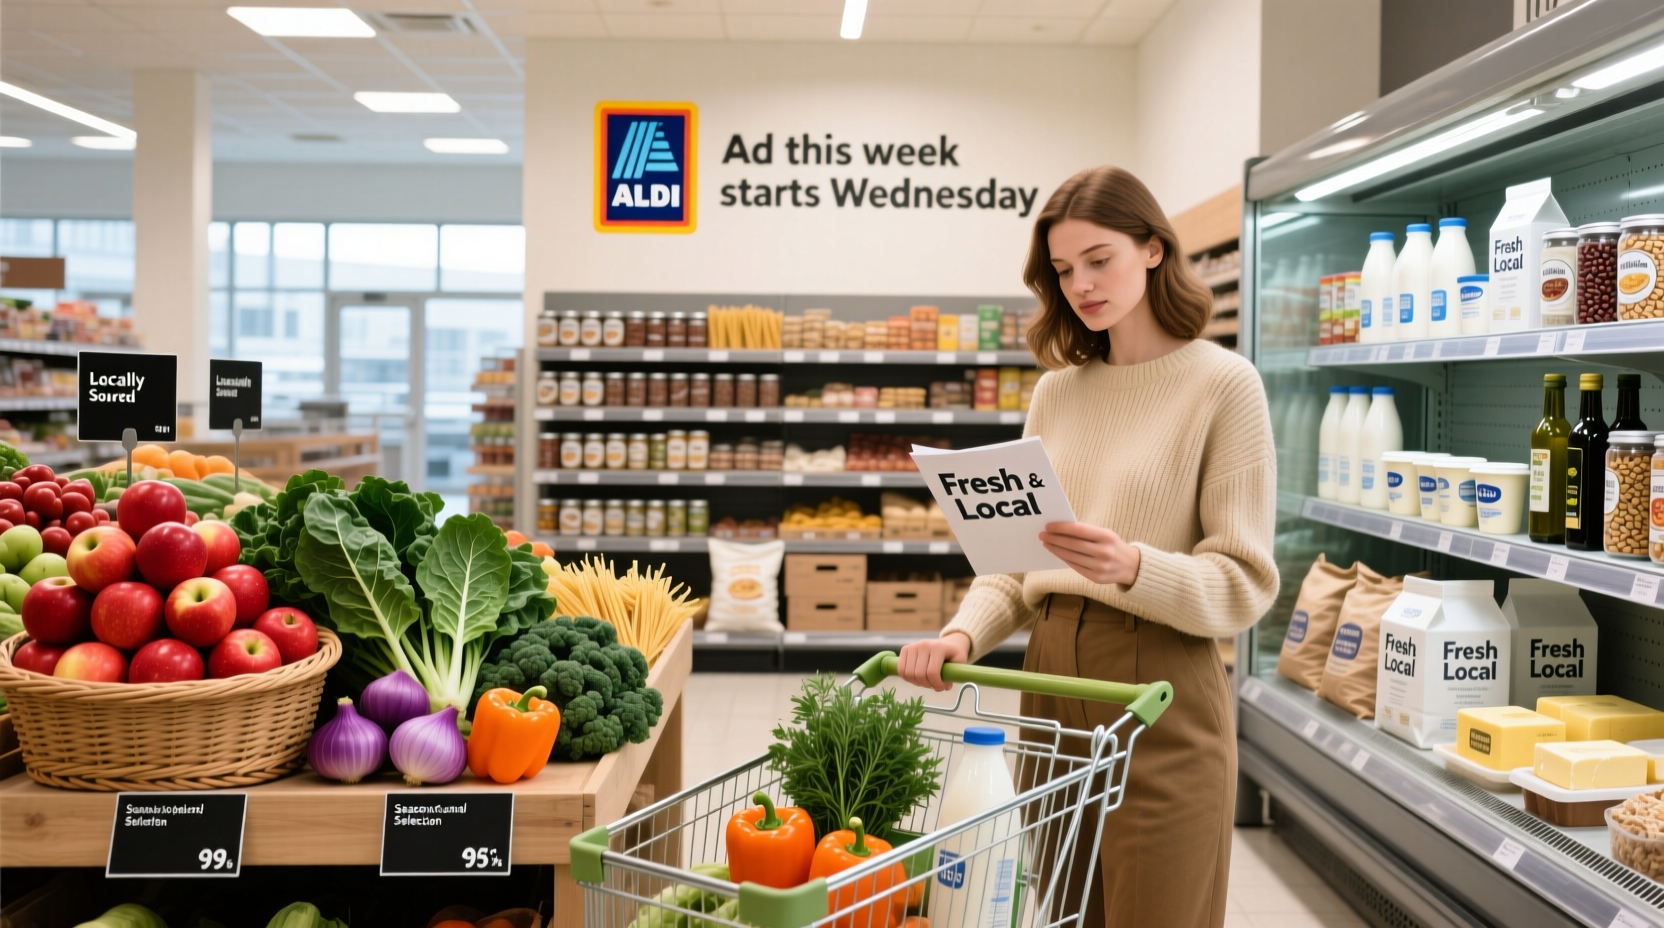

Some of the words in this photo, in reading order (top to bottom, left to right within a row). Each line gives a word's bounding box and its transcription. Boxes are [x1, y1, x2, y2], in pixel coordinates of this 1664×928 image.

[722, 133, 773, 165] Ad
[786, 133, 852, 166] this
[863, 134, 959, 167] week
[611, 184, 681, 208] ALDI
[720, 178, 820, 208] starts
[830, 177, 1038, 217] Wednesday
[1494, 253, 1523, 273] Local
[89, 371, 145, 392] Locally
[938, 467, 1024, 496] Fresh
[1028, 472, 1046, 489] &
[954, 491, 1042, 521] Local
[1443, 639, 1498, 660] Fresh
[1530, 638, 1585, 659] Fresh
[1384, 652, 1417, 678] Local
[1443, 660, 1497, 681] Local
[1530, 659, 1584, 679] Local
